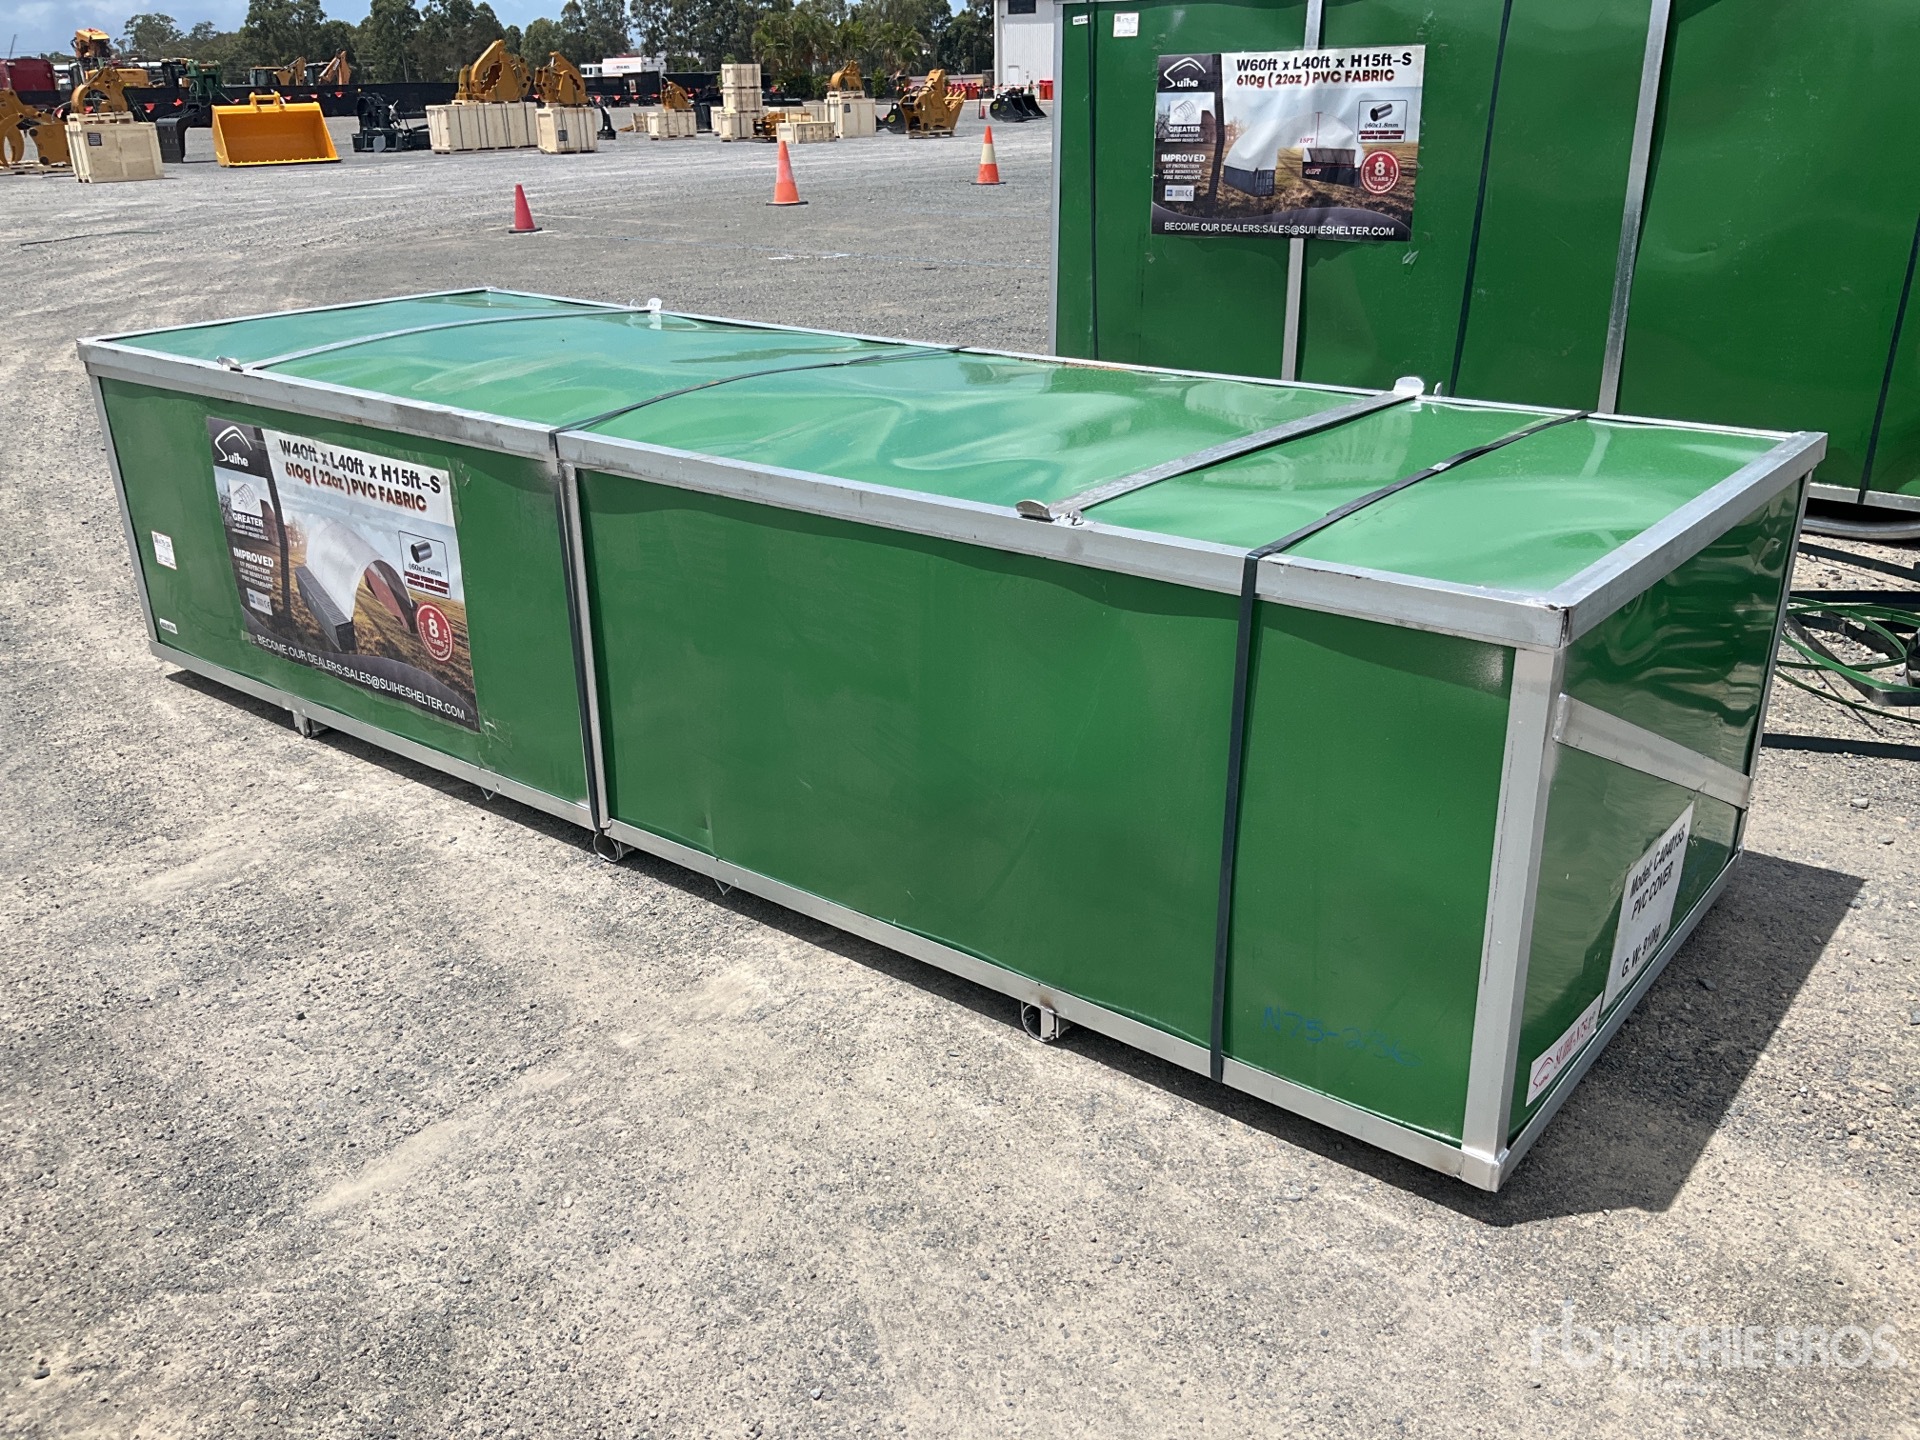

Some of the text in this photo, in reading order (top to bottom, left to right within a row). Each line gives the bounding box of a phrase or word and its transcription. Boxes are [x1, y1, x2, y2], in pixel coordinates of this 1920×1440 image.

[1236, 51, 1412, 71] W60ft x L40ft x H15ft-S
[1236, 74, 1265, 89] 610g
[1312, 71, 1342, 84] PVC
[1344, 69, 1395, 83] FABRIC
[1168, 125, 1201, 133] GREATER
[1161, 153, 1206, 163] IMPROVED
[1374, 161, 1386, 177] 8
[1164, 221, 1200, 232] BECOME
[1200, 222, 1220, 233] OUR
[278, 438, 442, 494] W40ft x L40ft x H15ft-S
[285, 461, 312, 485] 610g
[350, 478, 377, 499] PVC
[378, 485, 428, 512] FABRIC
[232, 512, 264, 528] GREATER
[232, 546, 275, 568] IMPROVED
[427, 618, 439, 638] 8
[256, 634, 289, 655] BECOME
[288, 646, 308, 661] OUR
[1631, 860, 1674, 920] PVC COVER
